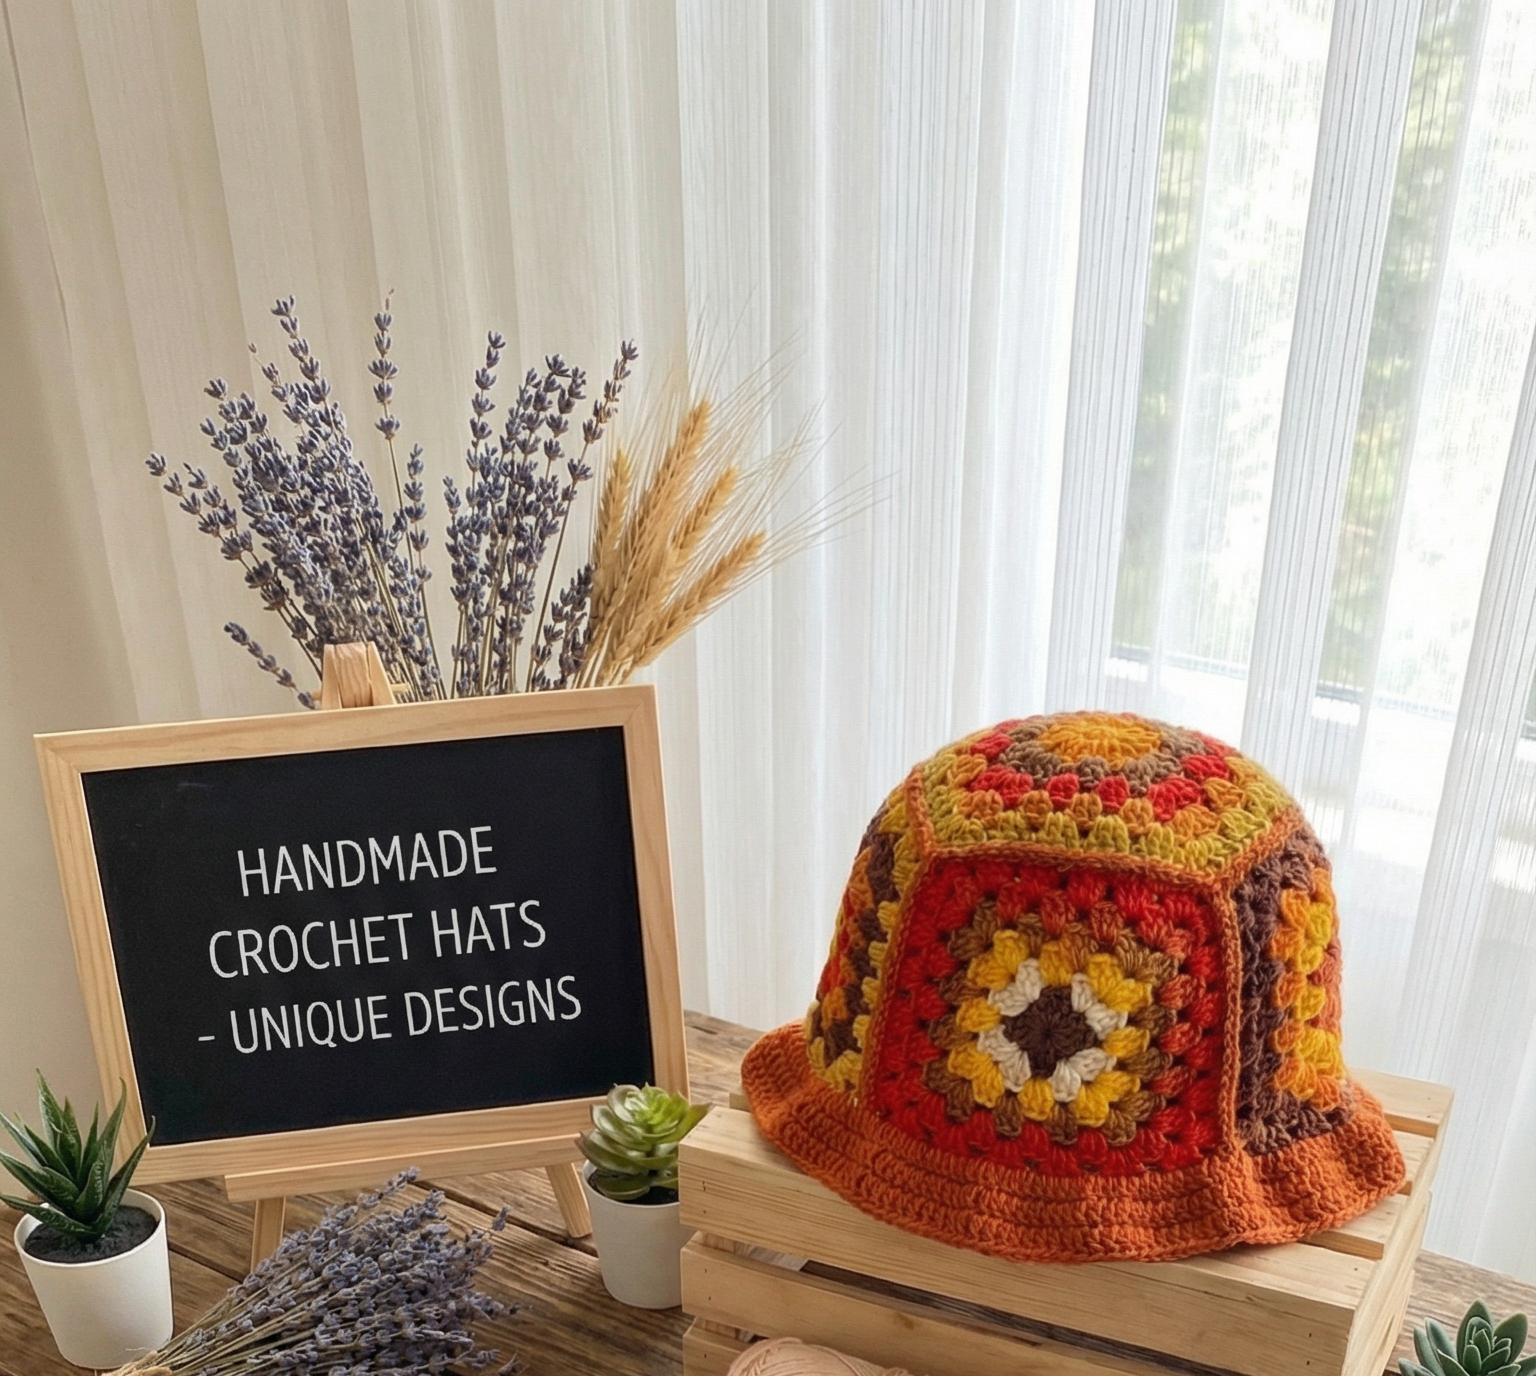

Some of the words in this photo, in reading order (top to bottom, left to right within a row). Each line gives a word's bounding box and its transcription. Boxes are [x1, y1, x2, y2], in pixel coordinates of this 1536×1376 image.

[237, 825, 497, 897] HANDMADE
[209, 912, 413, 979] CROCHET
[430, 899, 546, 958] HATS
[230, 995, 392, 1054] UNIQUE
[403, 975, 582, 1037] DESIGNS
